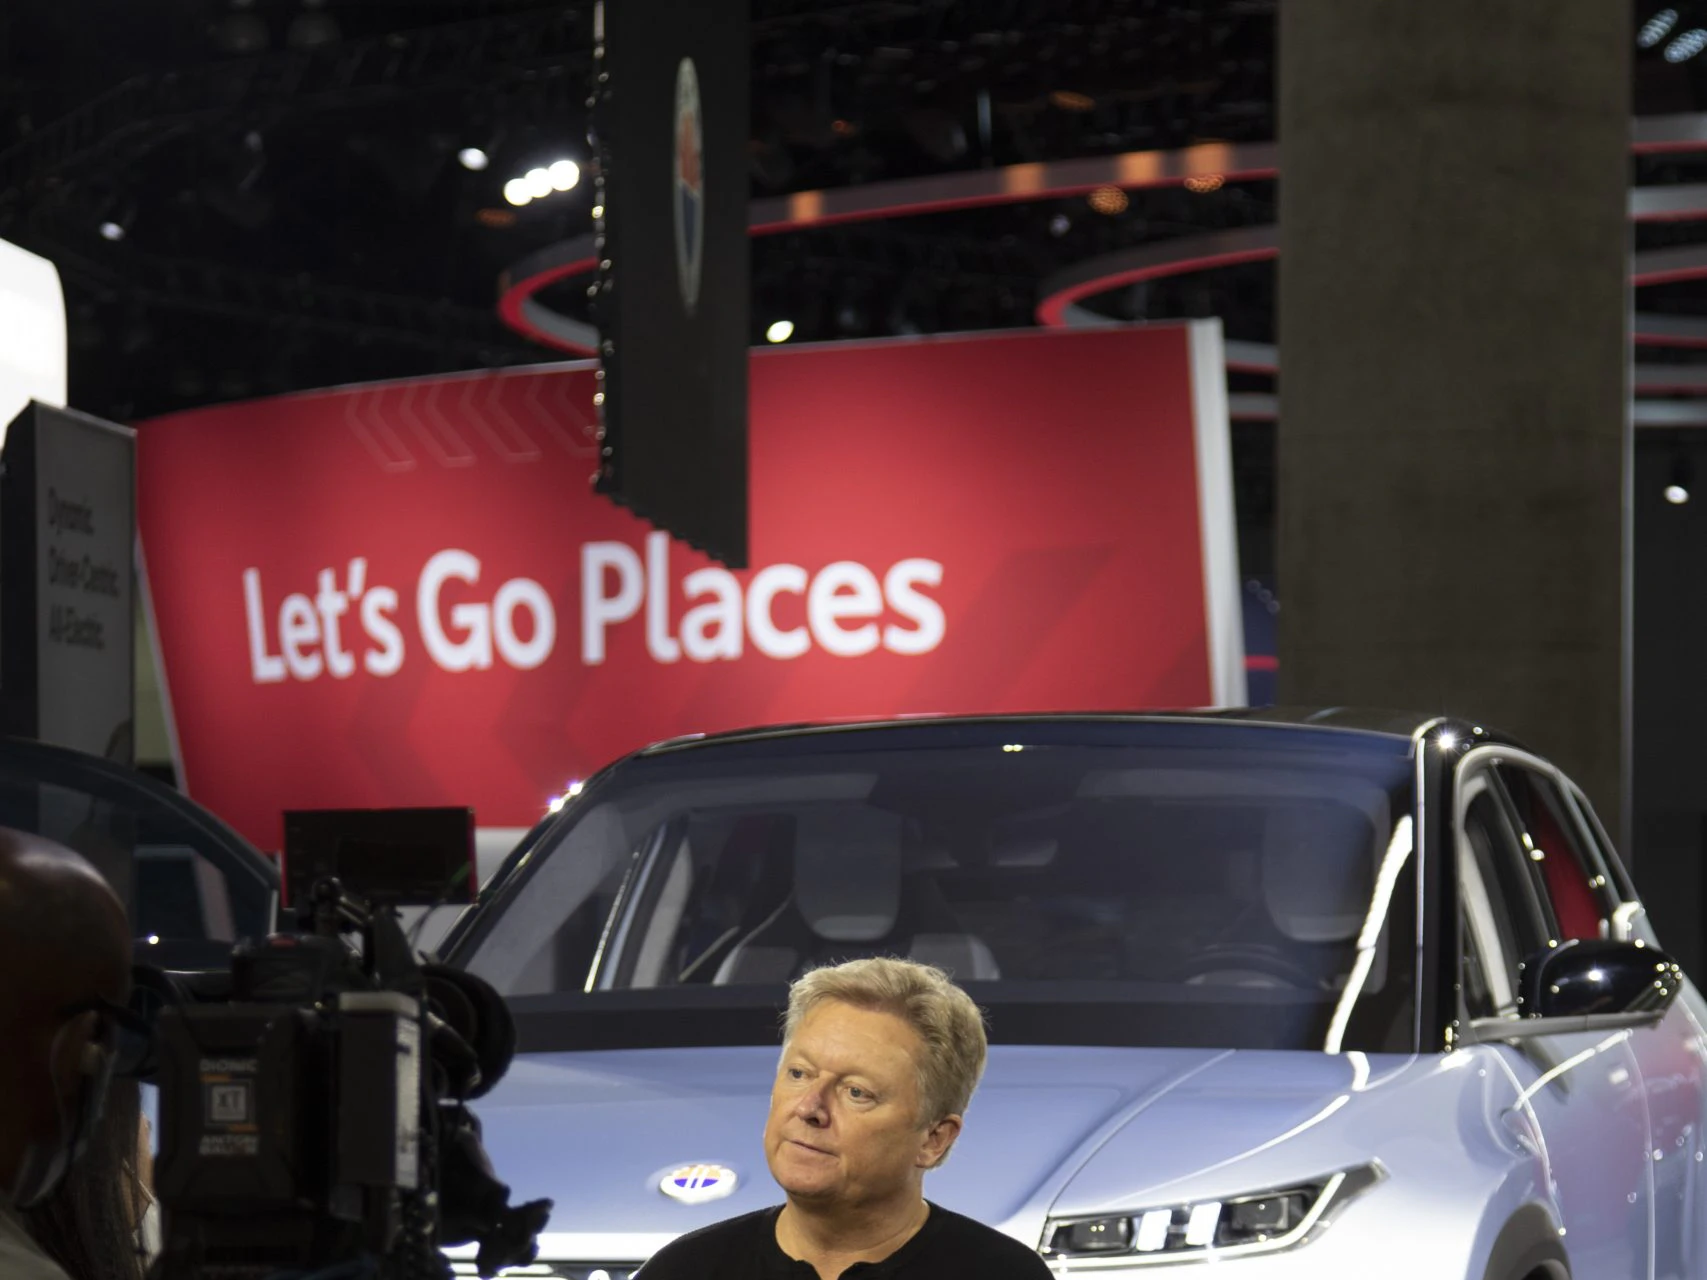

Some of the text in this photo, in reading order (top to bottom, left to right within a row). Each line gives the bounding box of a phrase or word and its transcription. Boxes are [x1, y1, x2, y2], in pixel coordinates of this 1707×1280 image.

[242, 530, 946, 683] Let’s Go Places
